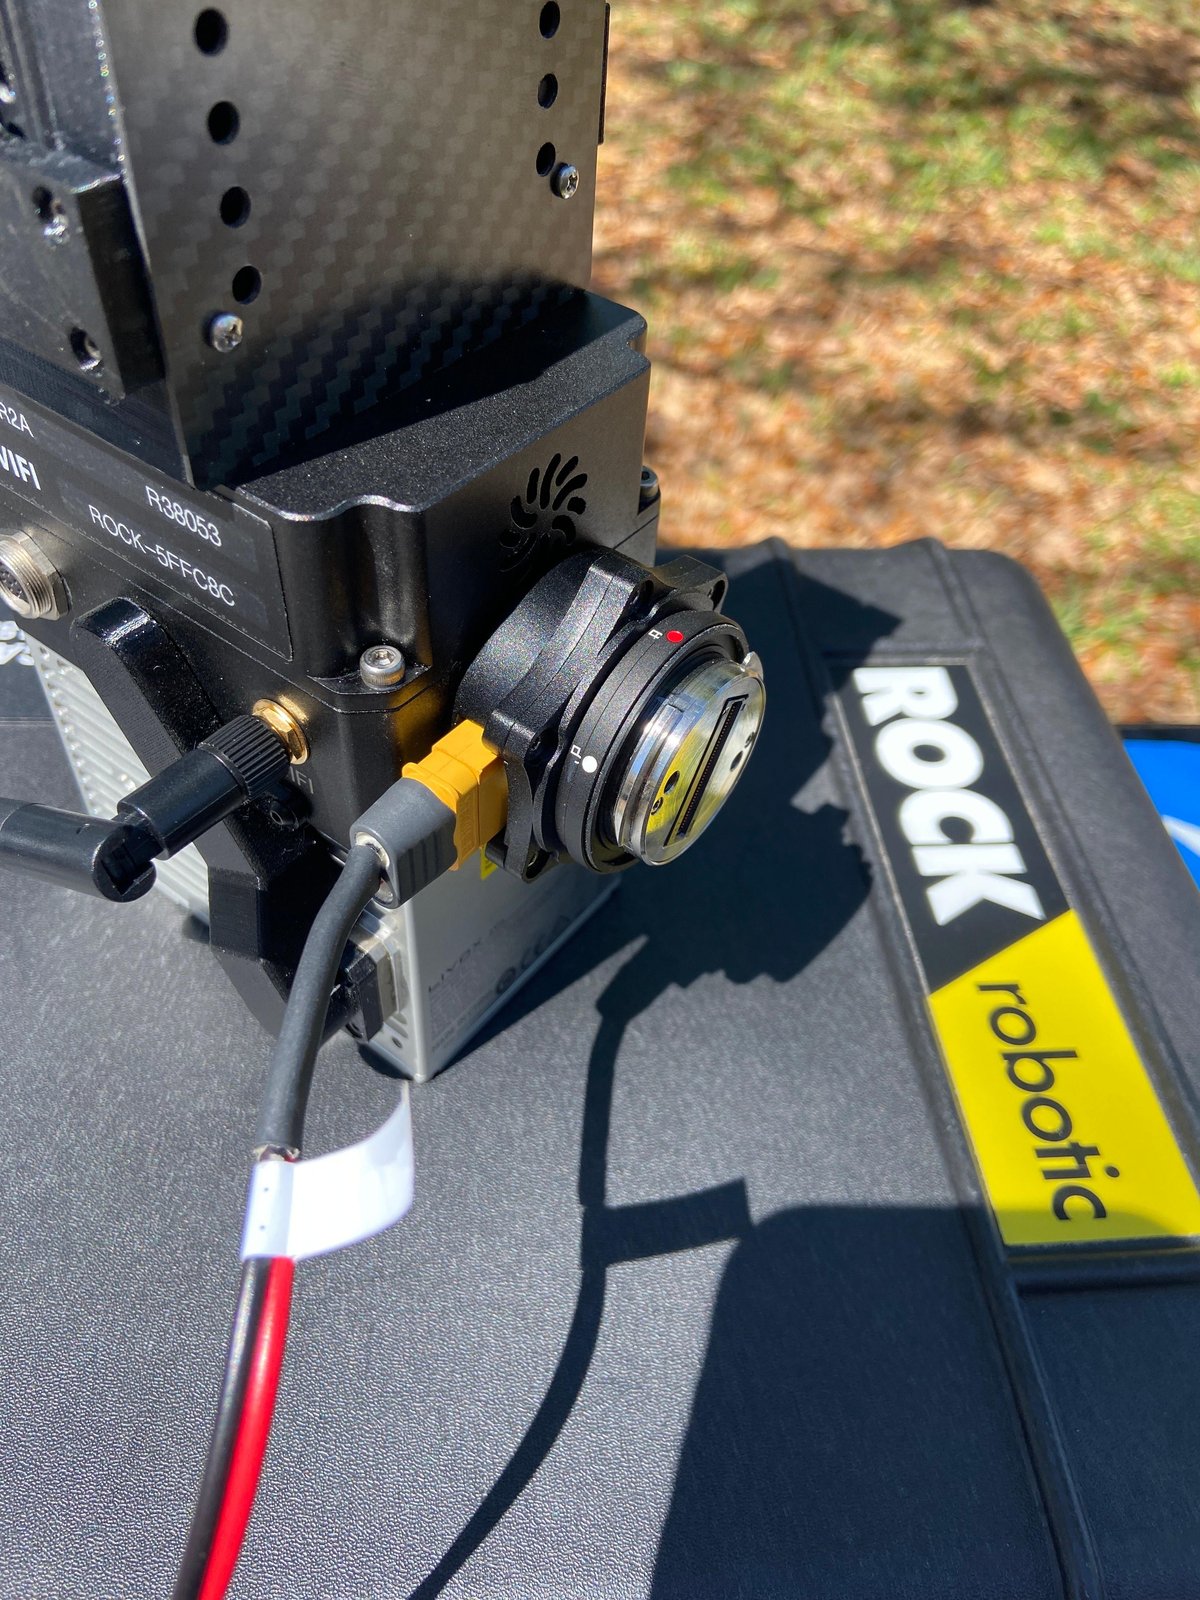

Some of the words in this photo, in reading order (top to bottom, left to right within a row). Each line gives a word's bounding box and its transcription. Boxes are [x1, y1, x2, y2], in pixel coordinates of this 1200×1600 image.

[88, 504, 235, 607] ROCK-5FFC8C
[145, 485, 222, 547] R38053
[853, 666, 1047, 927] ROCK
[974, 980, 1121, 1222] robotic
